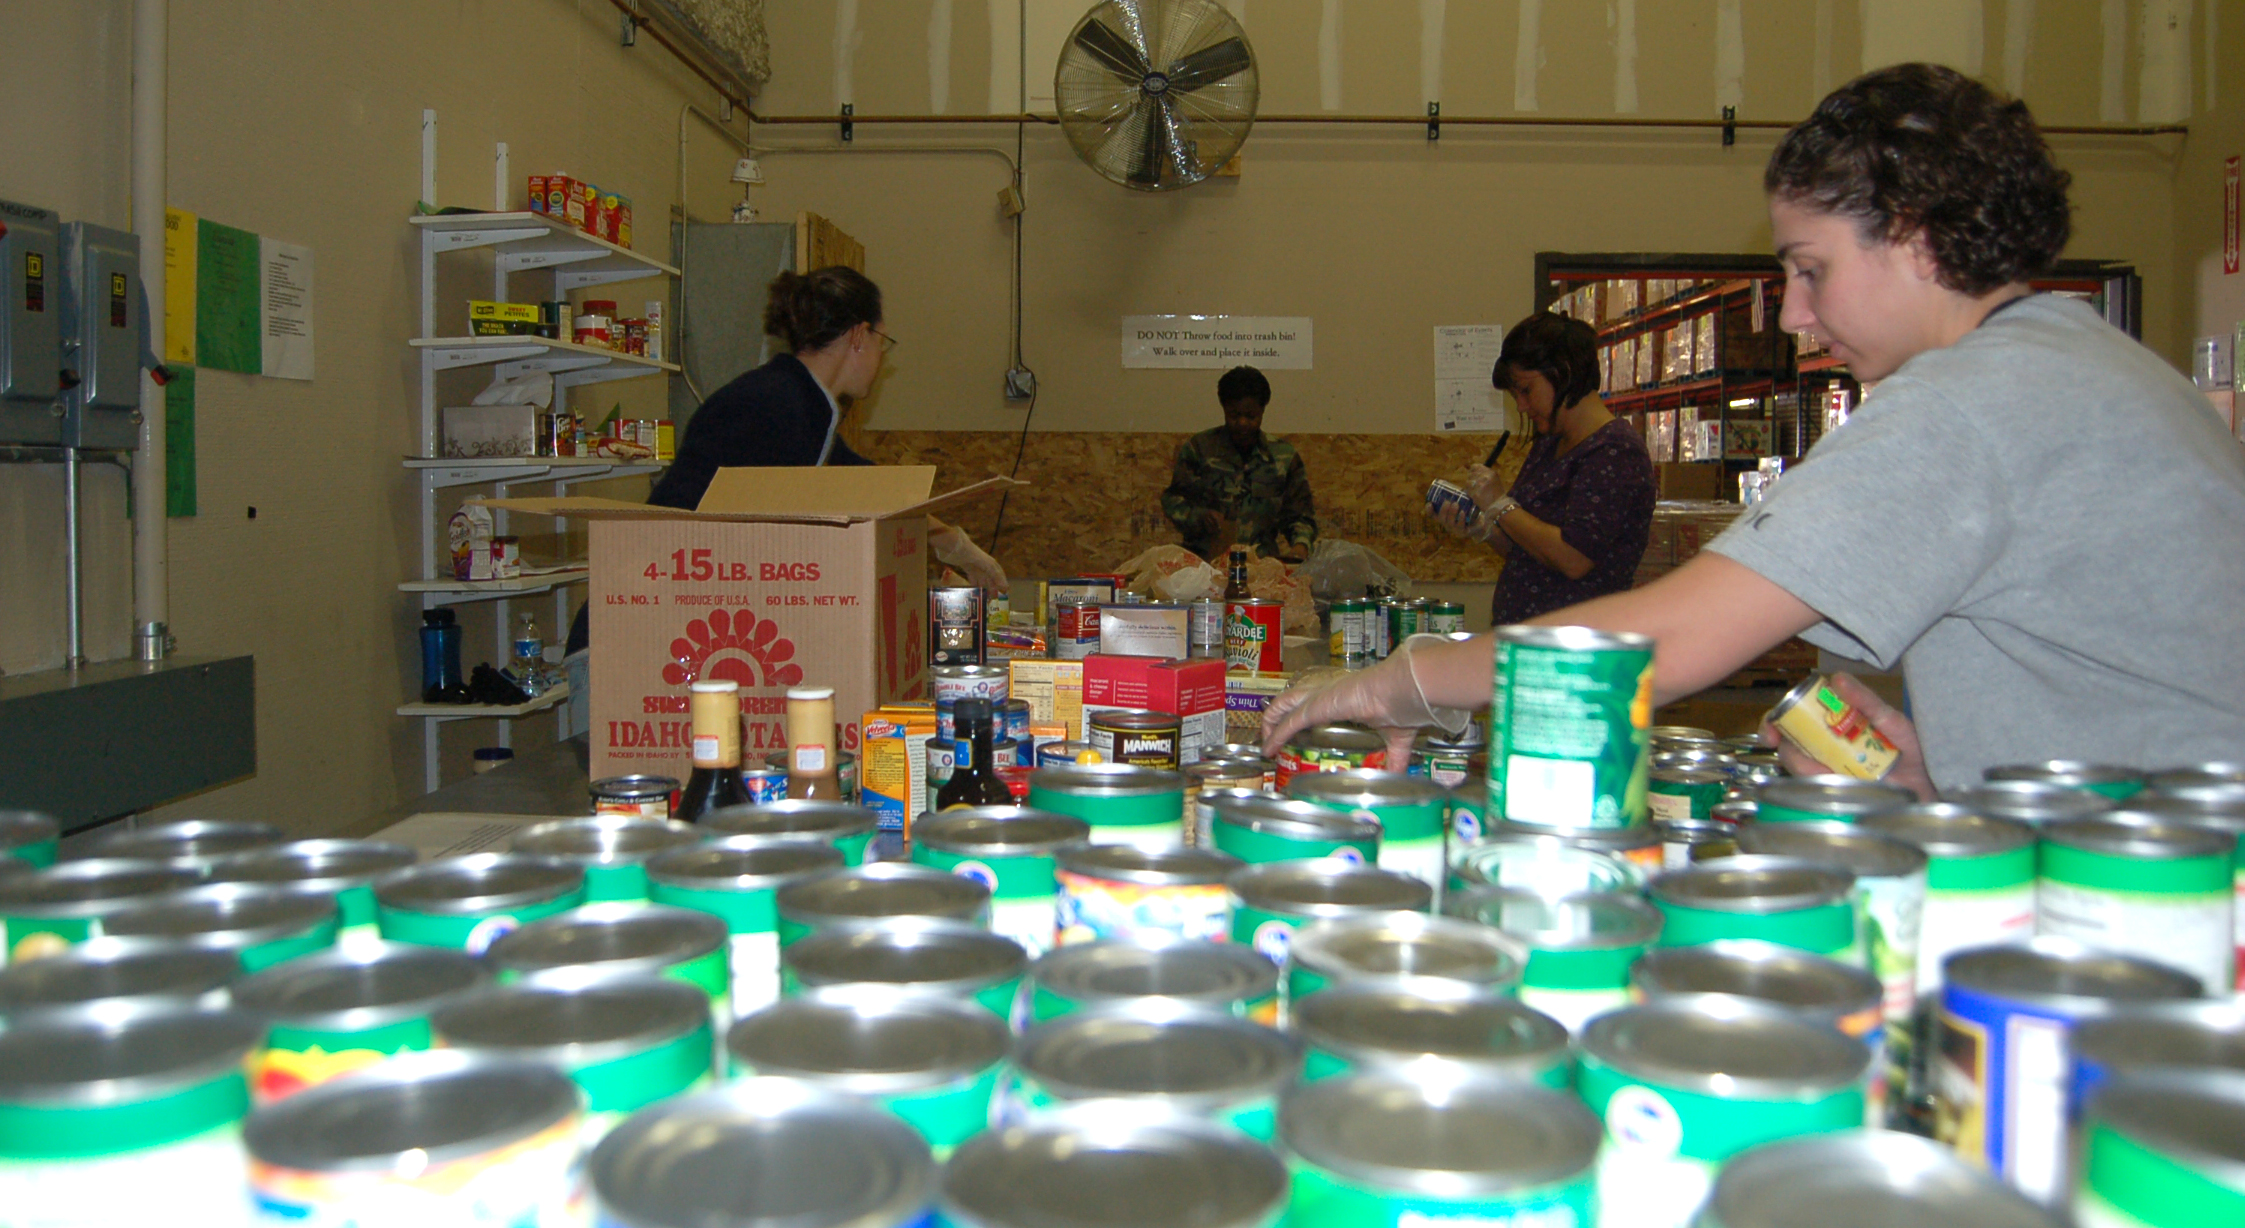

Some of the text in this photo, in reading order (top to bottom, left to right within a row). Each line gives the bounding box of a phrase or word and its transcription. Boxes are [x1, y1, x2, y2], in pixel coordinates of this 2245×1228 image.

[1137, 331, 1296, 341] DO NOT Throw food into trash bin!
[1152, 347, 1177, 356] Walk
[1200, 347, 1217, 356] and
[1219, 347, 1242, 358] place
[1243, 348, 1251, 357] it
[1252, 347, 1280, 357] inside.
[718, 563, 752, 581] LB.
[760, 563, 820, 581] BAGS
[606, 595, 660, 605] U.S. NO. 1
[675, 595, 750, 605] PRODUCE OF U.S.A.
[766, 596, 860, 606] 60 LBS. NET WT.
[1053, 593, 1099, 603] Macaroni
[1124, 738, 1172, 755] MANWICH
